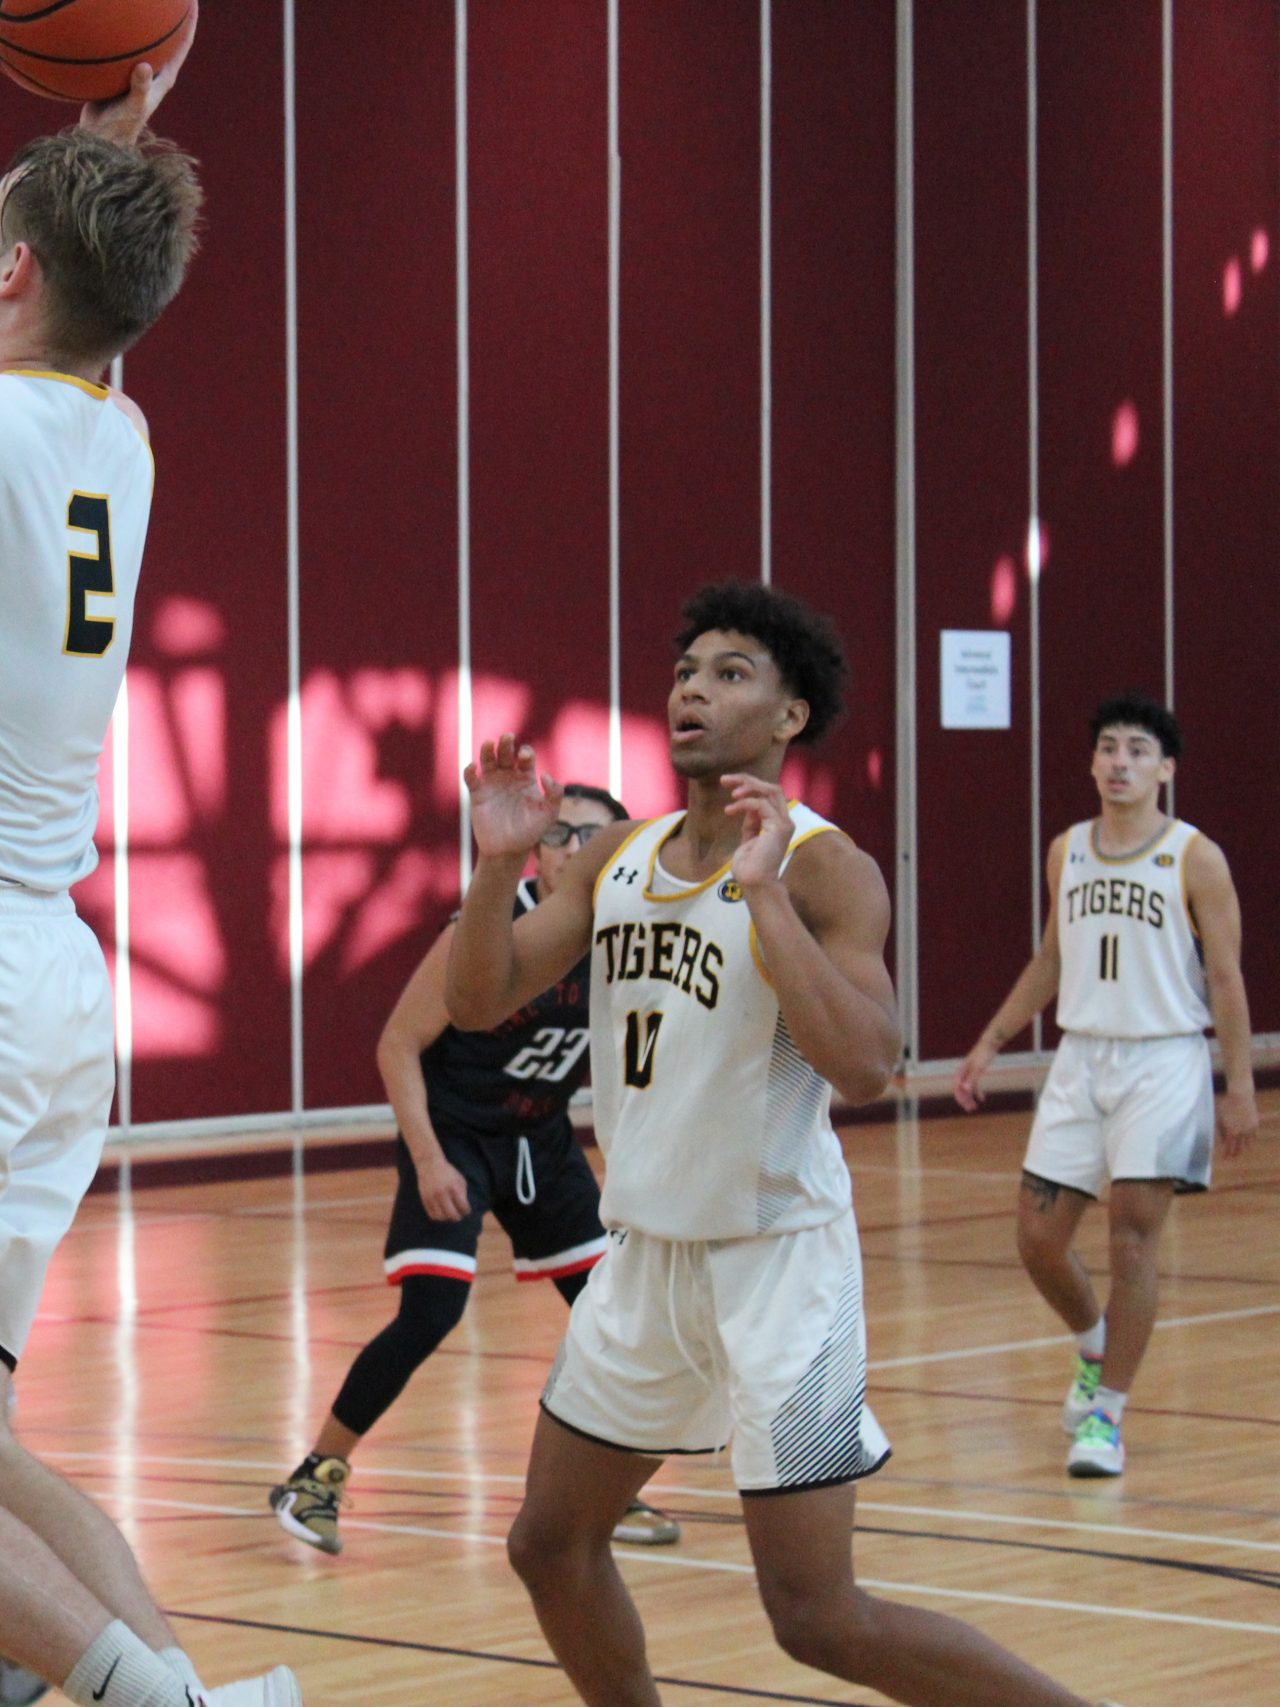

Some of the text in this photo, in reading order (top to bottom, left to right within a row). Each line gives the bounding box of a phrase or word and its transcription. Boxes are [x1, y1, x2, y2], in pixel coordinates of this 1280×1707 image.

[61, 489, 116, 658] 2
[1067, 878, 1166, 930] TIGERS
[595, 921, 724, 1011] TIGERS
[1099, 933, 1119, 982] 11
[502, 1026, 591, 1082] 23
